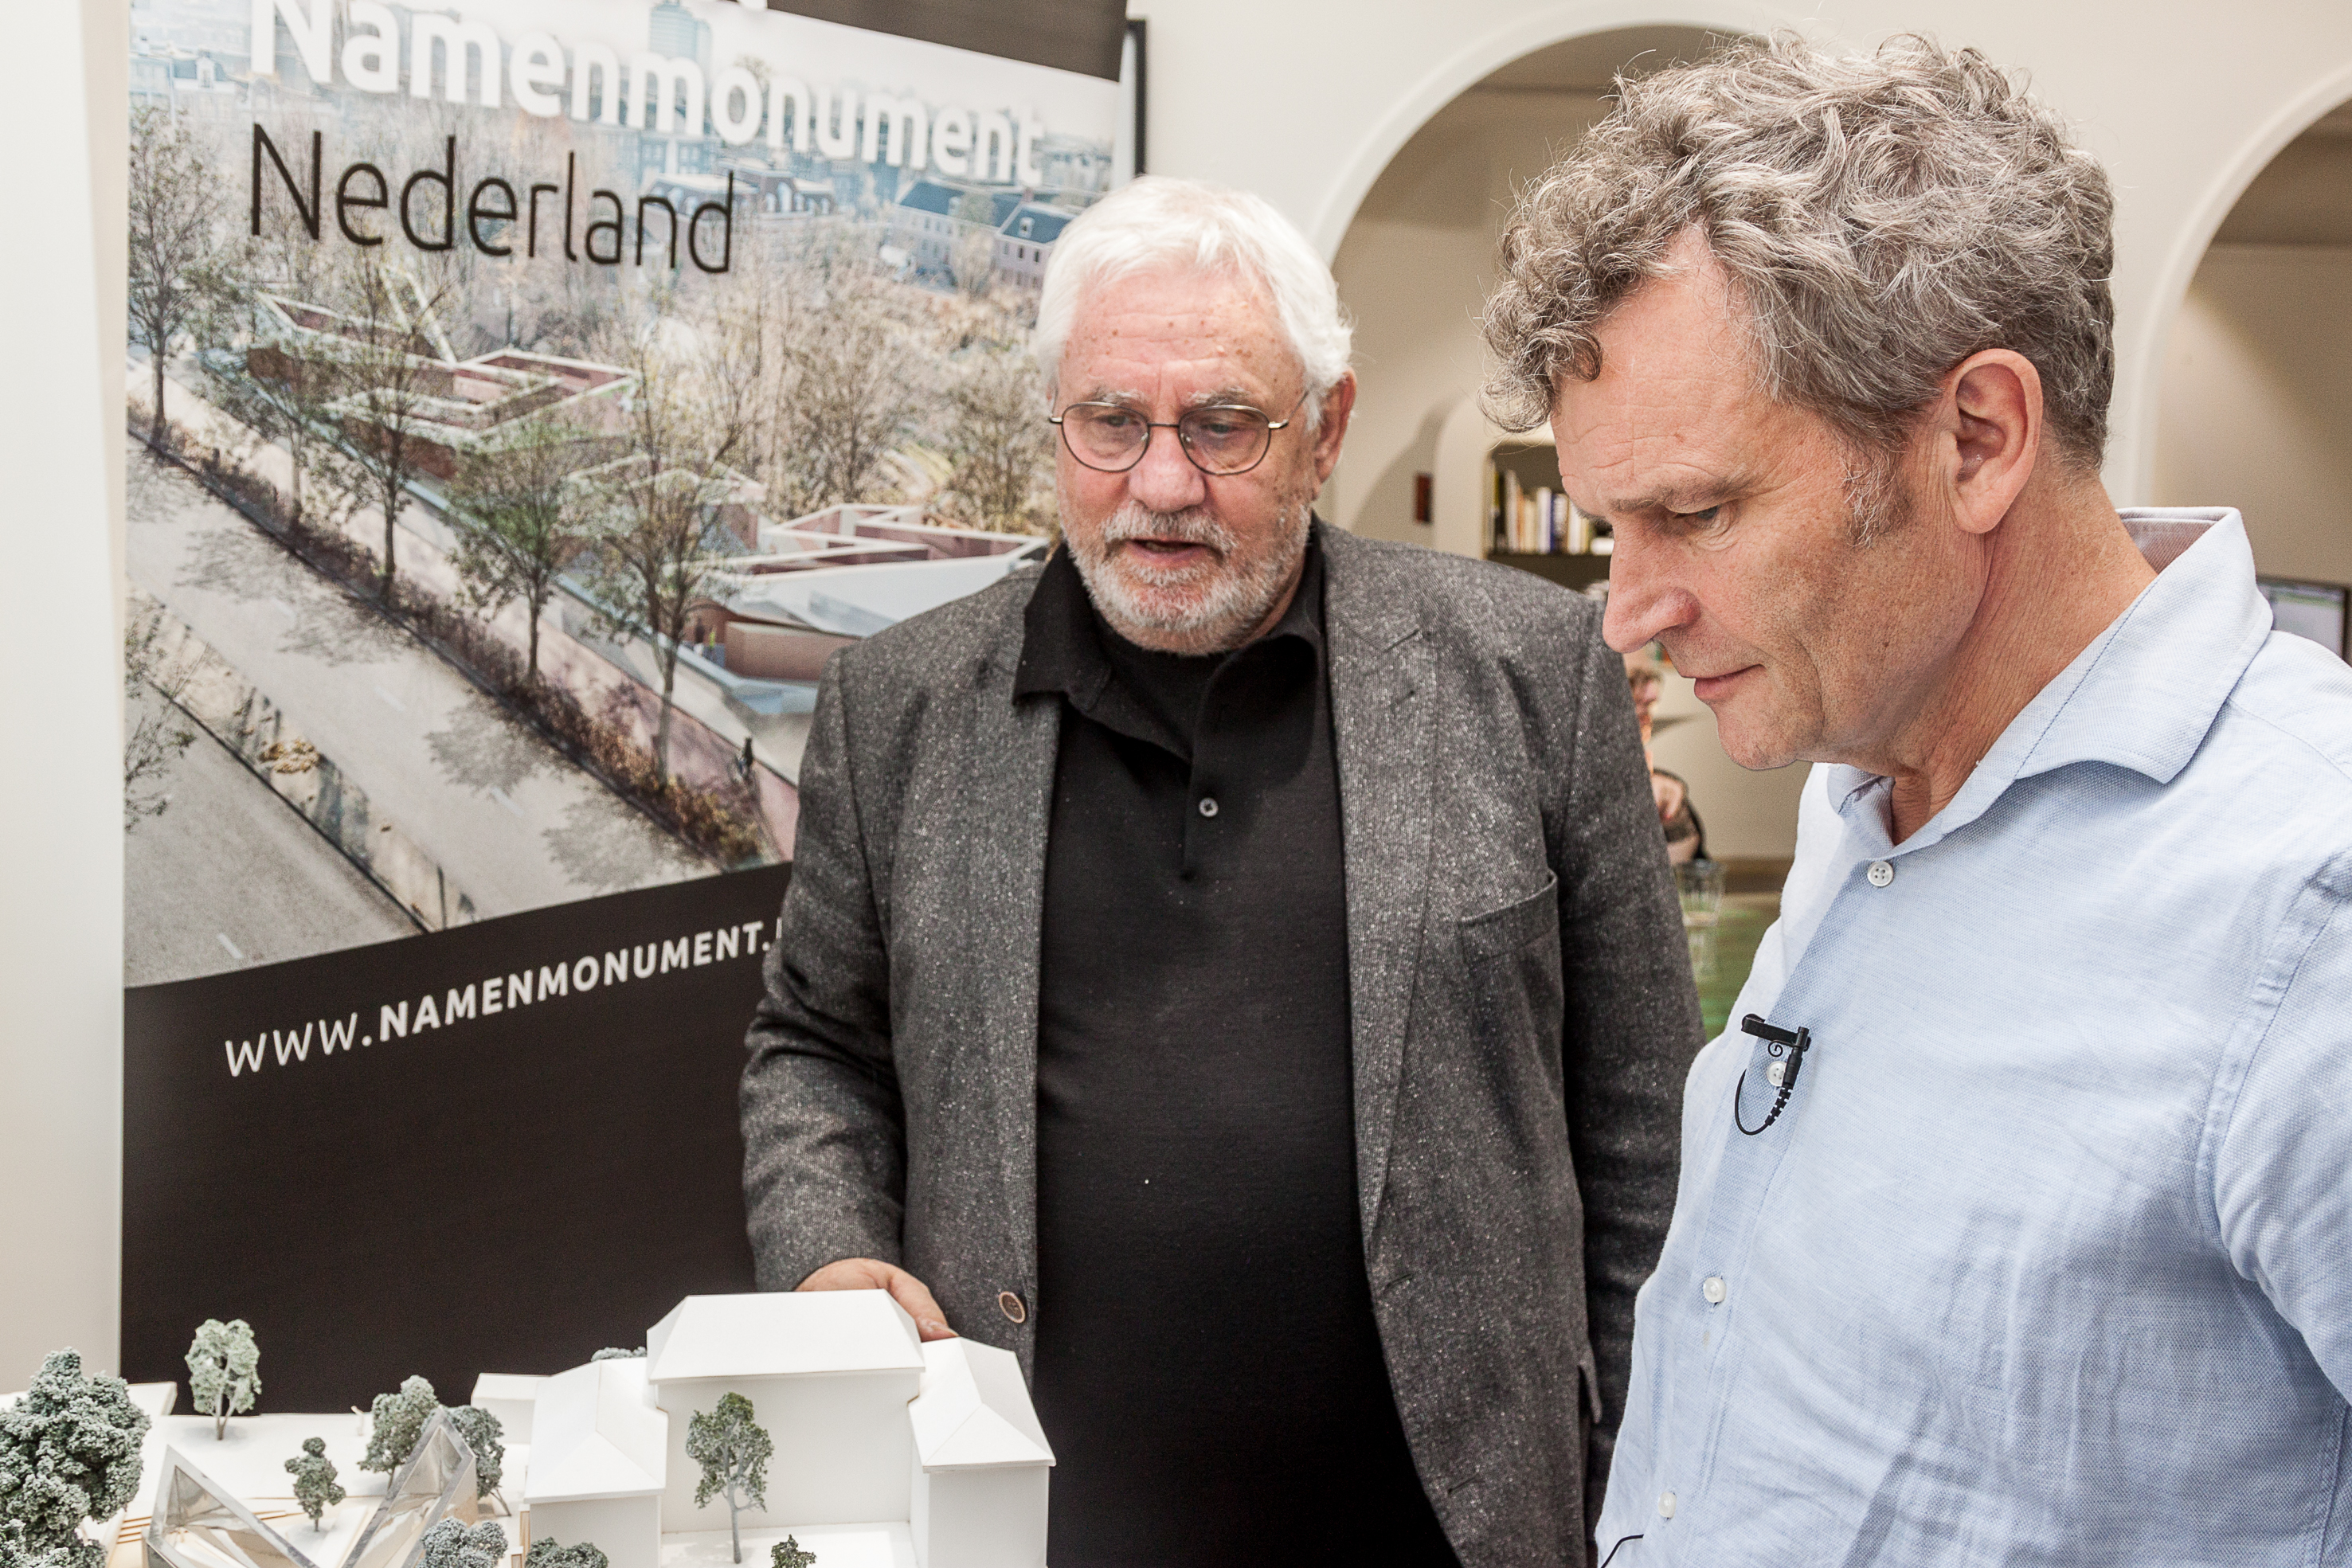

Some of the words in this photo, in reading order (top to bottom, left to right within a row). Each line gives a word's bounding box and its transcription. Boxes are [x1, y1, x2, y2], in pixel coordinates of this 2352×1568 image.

[250, 0, 1046, 186] Namenmonument
[250, 122, 734, 274] Nederland
[225, 917, 783, 1077] WWW.NAMENMONUMENT.
